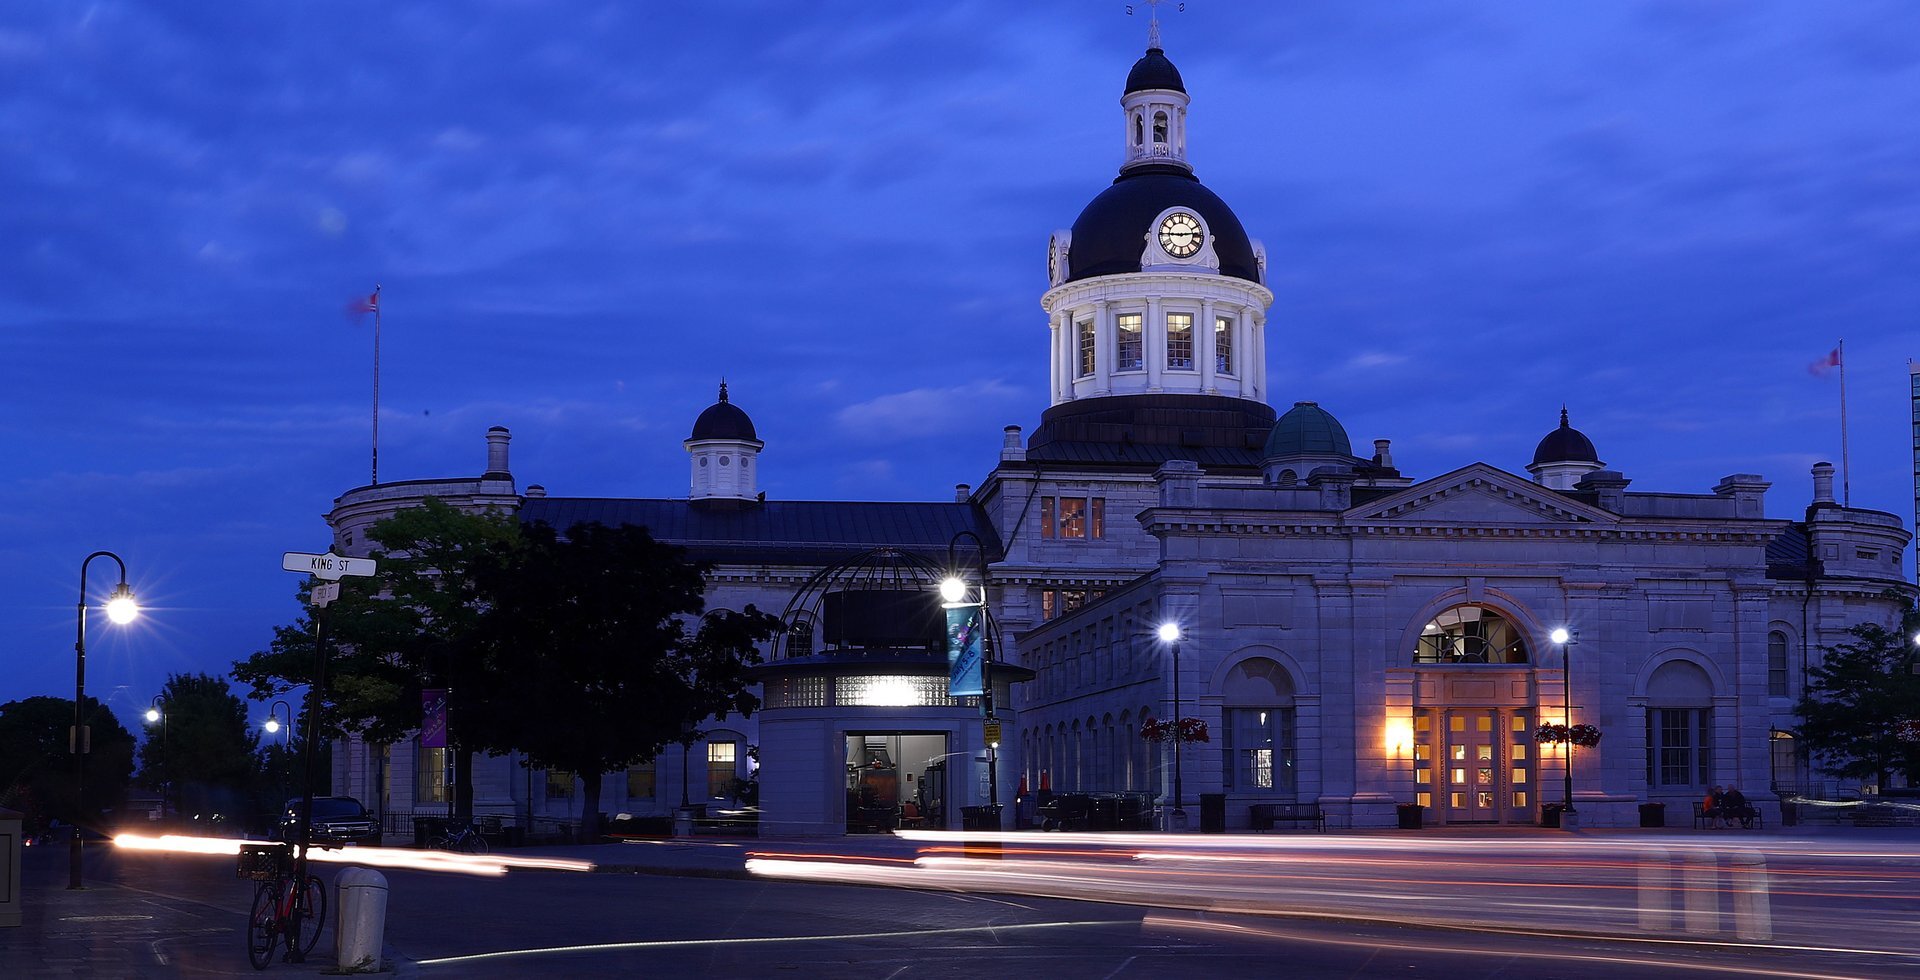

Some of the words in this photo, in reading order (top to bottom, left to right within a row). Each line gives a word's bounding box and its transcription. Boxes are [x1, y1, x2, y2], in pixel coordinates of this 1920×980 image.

[311, 558, 332, 570] KING
[338, 560, 350, 571] ST
[953, 664, 964, 678] July
